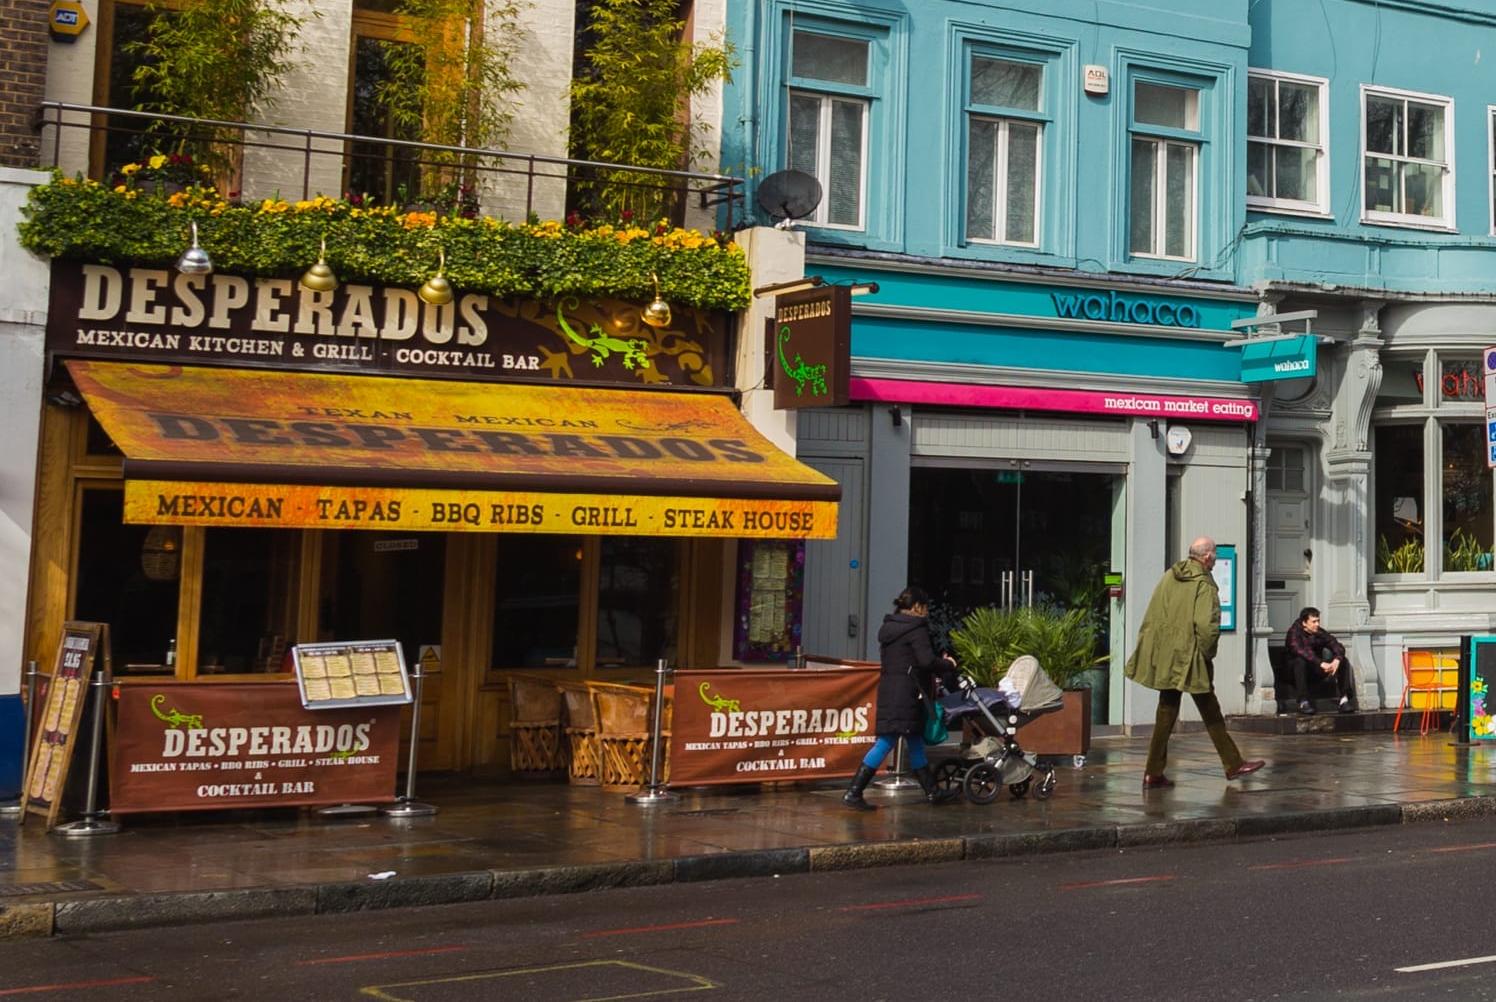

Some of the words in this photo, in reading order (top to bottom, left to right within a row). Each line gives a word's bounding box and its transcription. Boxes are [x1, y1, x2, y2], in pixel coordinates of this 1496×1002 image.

[78, 265, 488, 346] DESPERADOS
[778, 300, 831, 323] DESPERADOS
[1052, 290, 1201, 328] wahaca
[76, 329, 181, 350] MEXICAN
[189, 336, 284, 356] KITCHEN
[292, 343, 304, 357] &
[313, 343, 373, 360] GRILL
[396, 349, 495, 368] COCKTAIL
[502, 354, 540, 370] BAR
[1274, 359, 1309, 373] wahaca
[297, 406, 413, 420] TEXAN
[454, 414, 598, 428] MEXICAN
[1104, 397, 1160, 412] mexican
[1164, 400, 1209, 414] market
[1212, 402, 1253, 418] eating
[148, 413, 766, 464] DESPERADOS
[157, 494, 283, 519] MEXICAN
[316, 499, 401, 522] TAPAS
[431, 502, 481, 526] BBQ
[490, 503, 544, 525] RIBS
[571, 506, 637, 527] GRILL
[664, 508, 735, 529] STEAK
[743, 510, 814, 531] HOUSE
[709, 706, 869, 738] DESPERADOS
[162, 723, 370, 757] DESPERADOS
[685, 742, 721, 751] MEXICAN
[723, 741, 748, 749] TAPAS
[754, 740, 770, 748] BBQ
[771, 739, 790, 747] RIBS
[795, 738, 818, 746] GRILL
[824, 736, 849, 745] STEAK
[131, 763, 177, 773] MEXICAN
[179, 762, 211, 771] TAPAS
[220, 761, 243, 771] BBQ
[245, 760, 269, 769] RIBS
[278, 759, 307, 768] GRILL
[315, 757, 345, 766] STEAK
[348, 756, 380, 765] HOUSE
[736, 759, 797, 772] COCKTAIL
[800, 758, 825, 769] BAR
[254, 772, 262, 780] &
[197, 783, 278, 797] COCKTAIL
[282, 781, 314, 794] BAR
